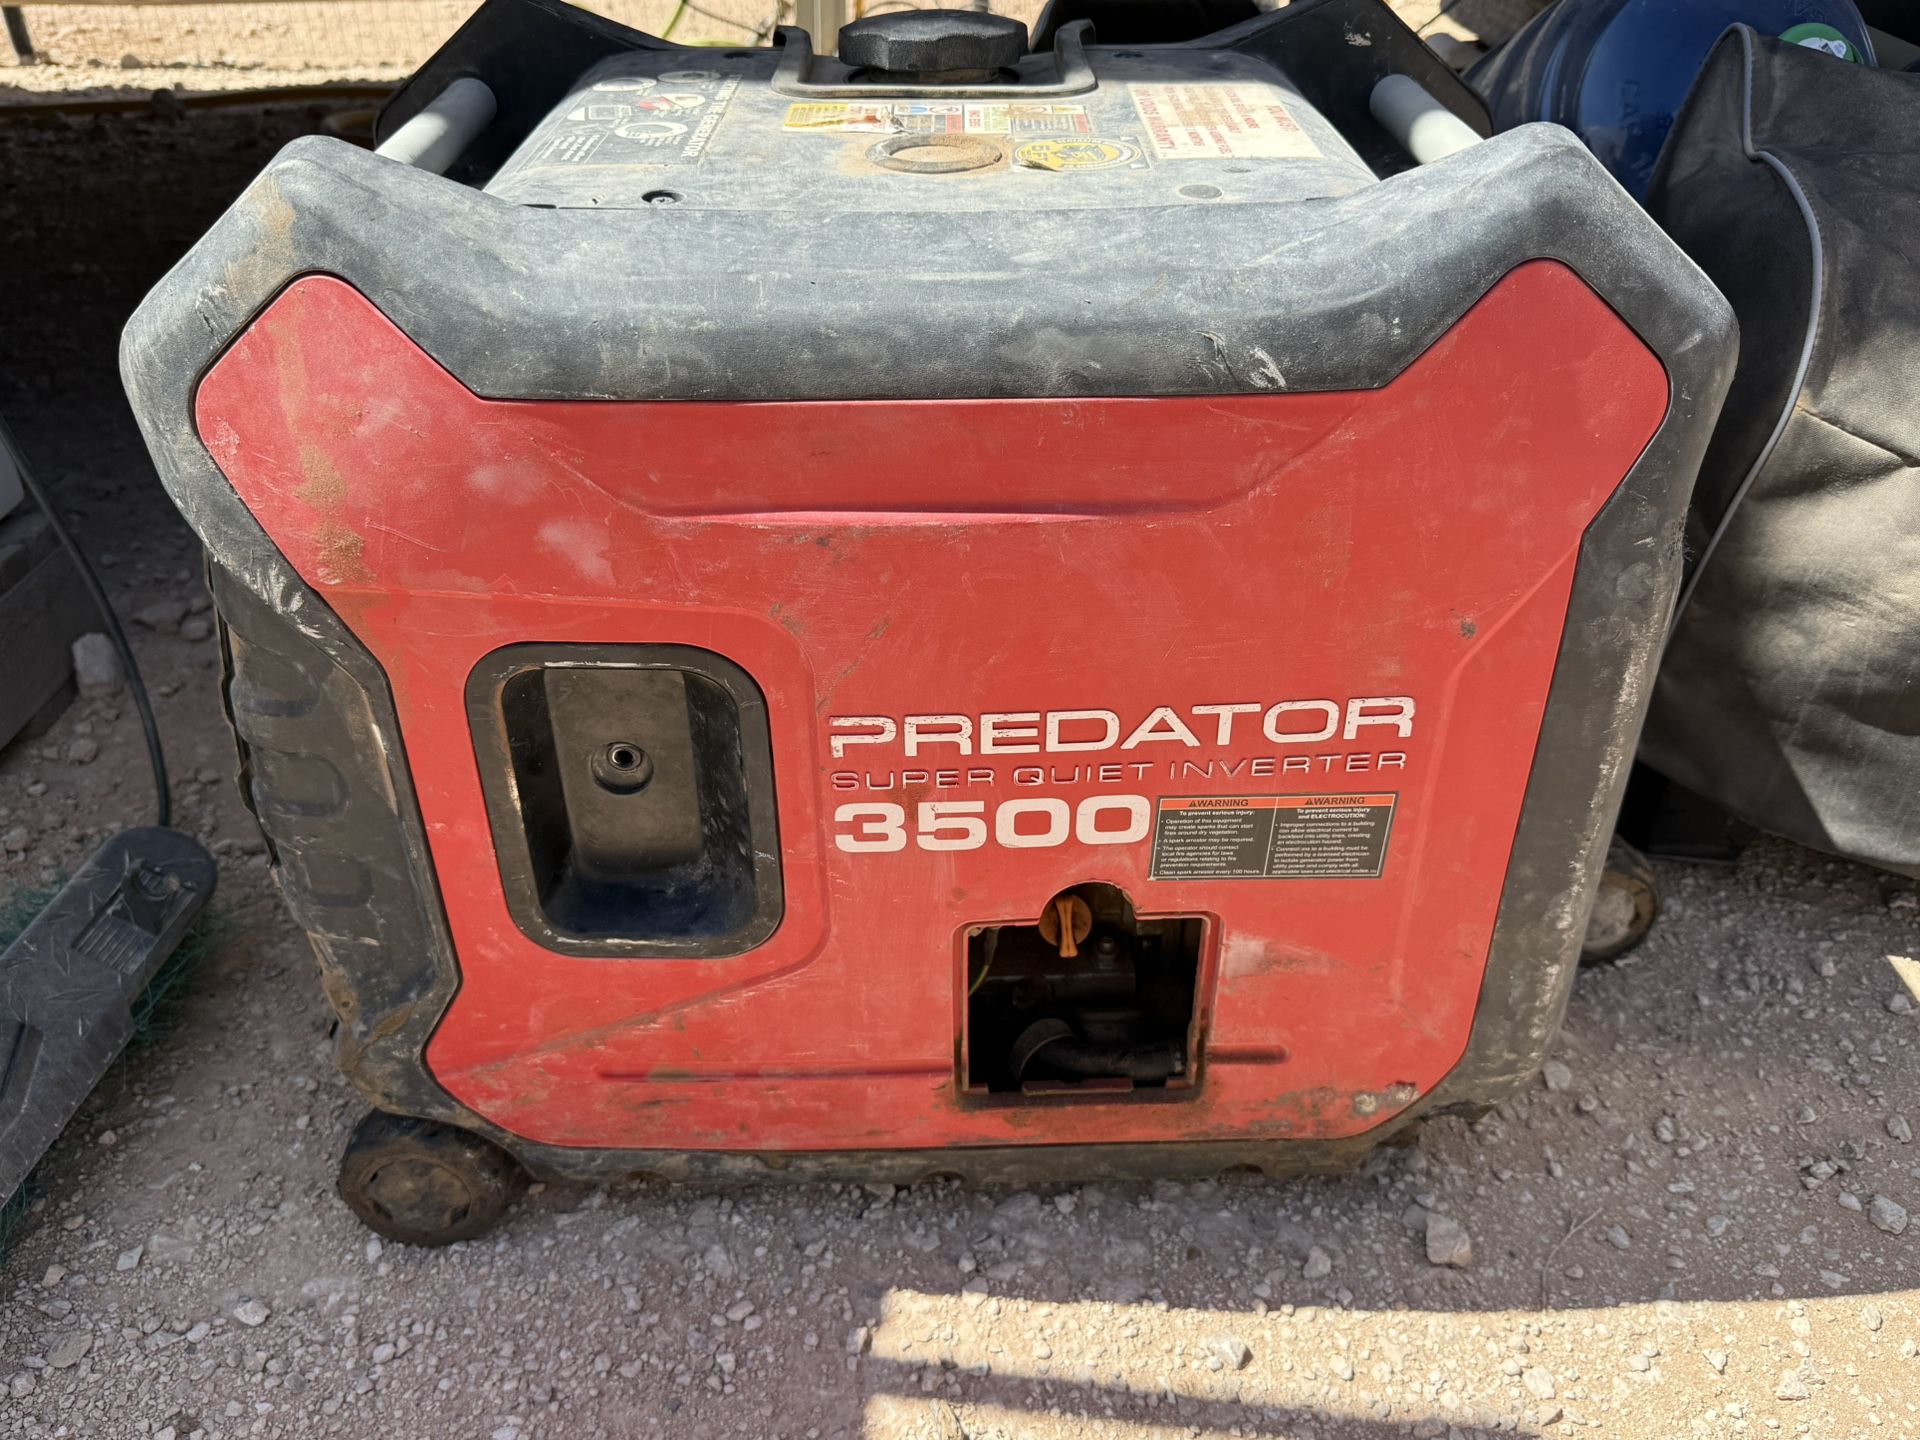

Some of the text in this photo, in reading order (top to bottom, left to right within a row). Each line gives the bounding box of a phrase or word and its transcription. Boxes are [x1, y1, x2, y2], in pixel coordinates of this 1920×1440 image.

[828, 696, 1417, 758] PREDATOR
[830, 752, 1407, 792] SUPER QUIET INVERTER
[1197, 799, 1249, 807] WARNING
[1315, 797, 1365, 805] WARNING
[834, 795, 1151, 853] 3500
